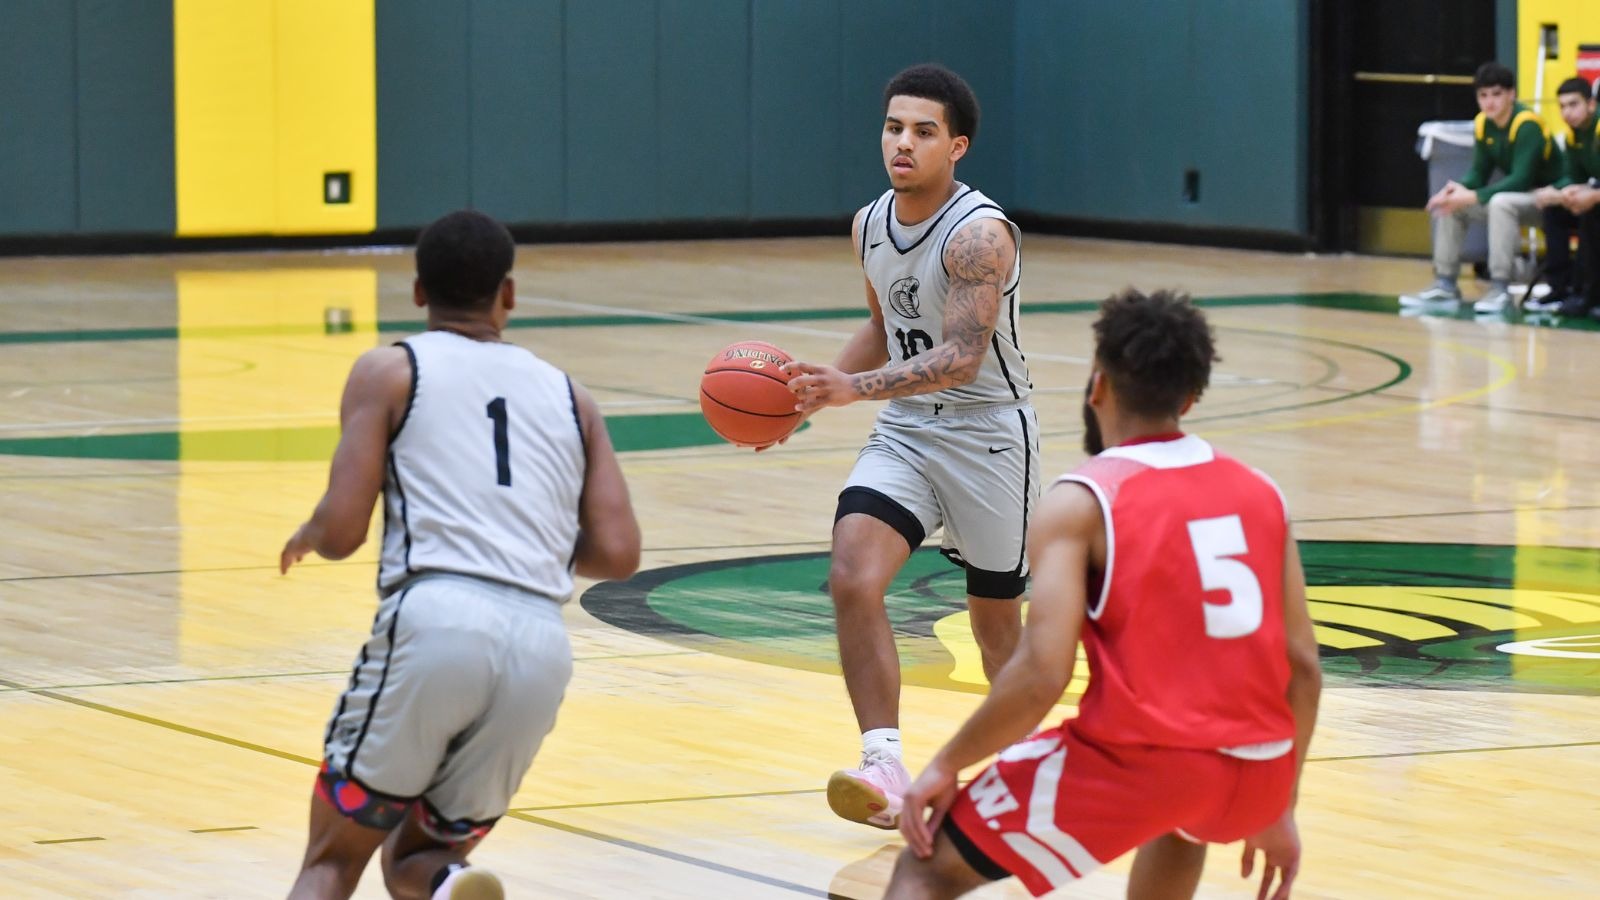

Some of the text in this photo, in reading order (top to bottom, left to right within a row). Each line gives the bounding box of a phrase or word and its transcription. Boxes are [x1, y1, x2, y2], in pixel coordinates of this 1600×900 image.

[724, 348, 787, 368] PALDING
[486, 396, 512, 487] 1
[1187, 513, 1263, 639] 5
